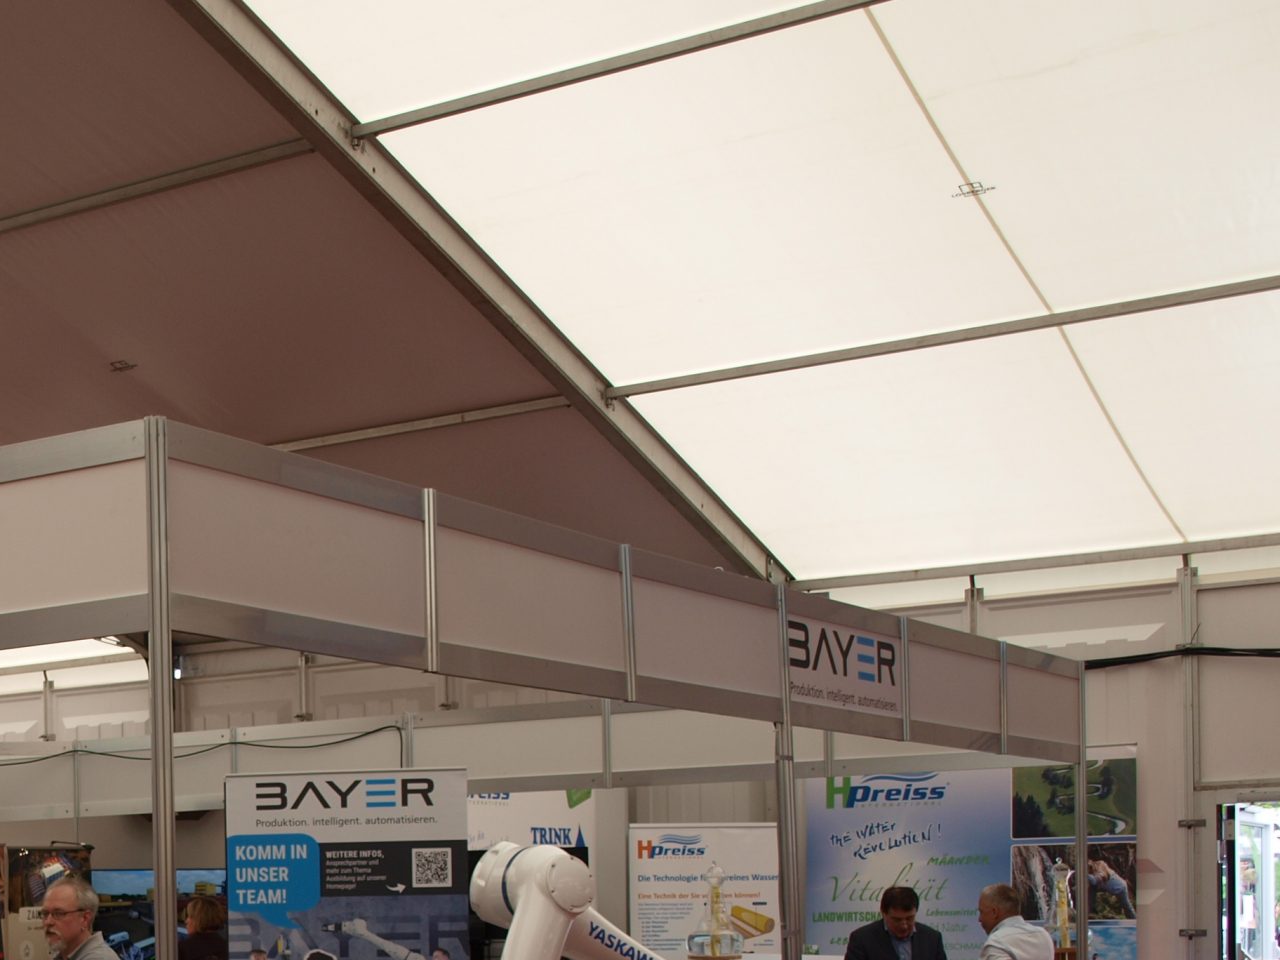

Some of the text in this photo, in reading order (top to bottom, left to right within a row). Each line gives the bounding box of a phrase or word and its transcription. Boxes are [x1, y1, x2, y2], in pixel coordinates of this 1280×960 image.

[788, 620, 896, 686] BAYER
[789, 681, 825, 699] Produktion.
[826, 687, 857, 707] intelligent.
[255, 777, 435, 811] BAYER
[255, 814, 439, 829] Produktion. intelligent. automatisieren.
[530, 826, 572, 846] TRINK
[235, 844, 308, 861] KOMM IN
[325, 850, 358, 858] WEITERE
[235, 866, 289, 884] UNSER
[637, 874, 651, 882] Die
[653, 874, 699, 883] Technologie
[235, 888, 288, 905] TEAM!
[812, 911, 882, 923] LANDWIRTSCHA
